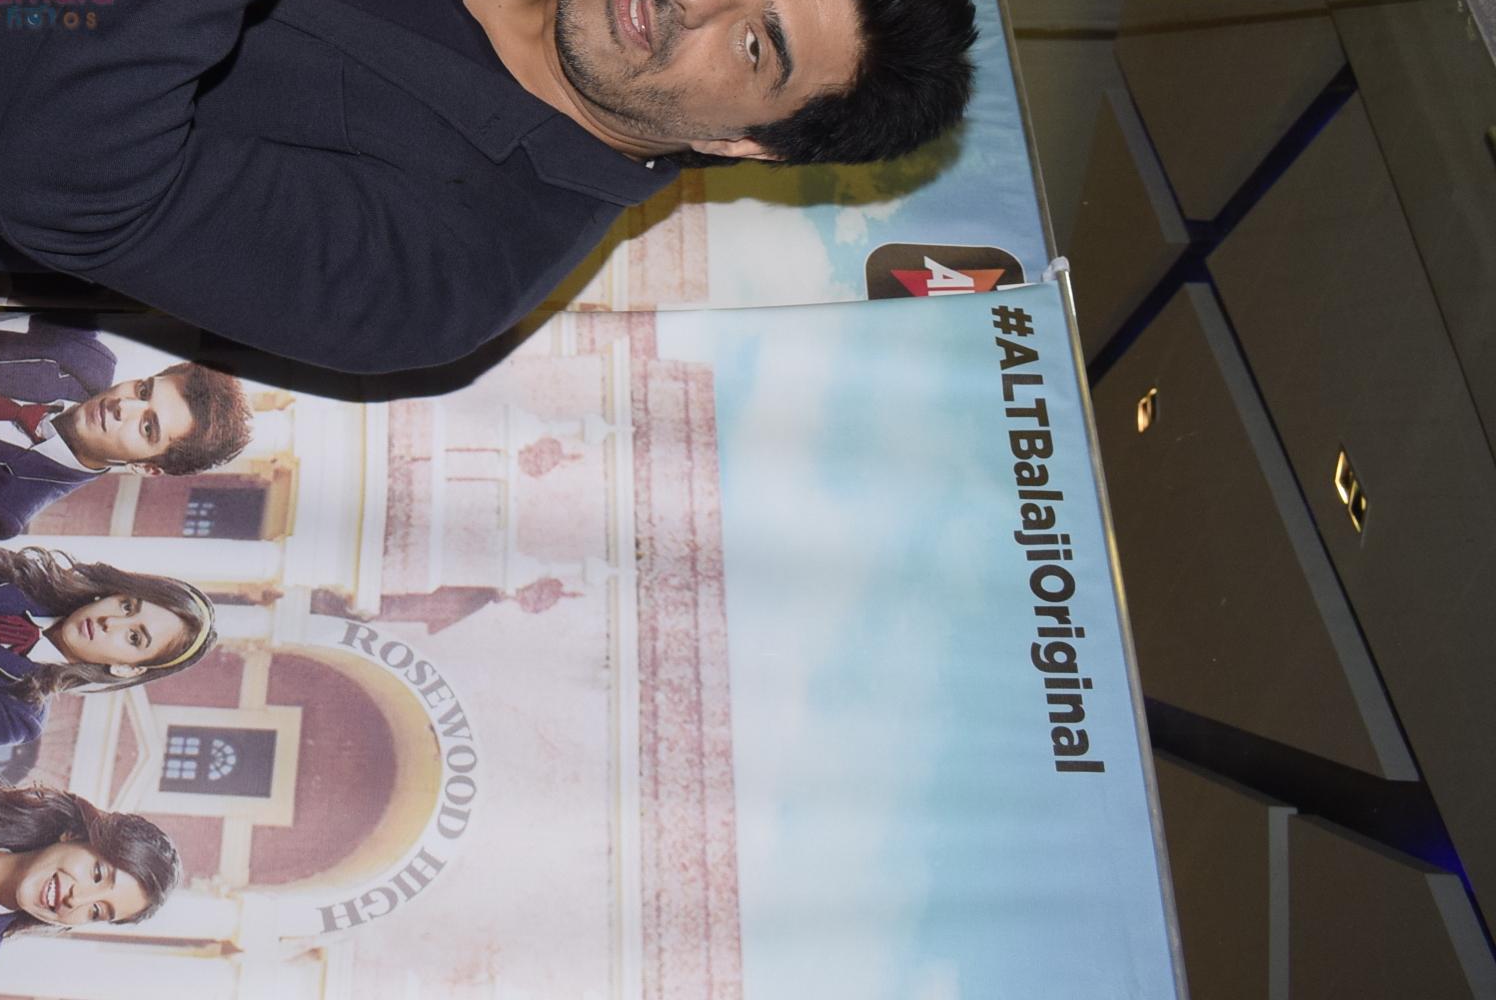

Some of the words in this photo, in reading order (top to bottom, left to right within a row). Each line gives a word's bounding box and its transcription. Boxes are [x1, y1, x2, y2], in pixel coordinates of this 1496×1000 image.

[992, 305, 1105, 773] #ALTBalajiOriginal
[338, 621, 478, 840] ROSEWOOD
[316, 847, 447, 935] HIGH
